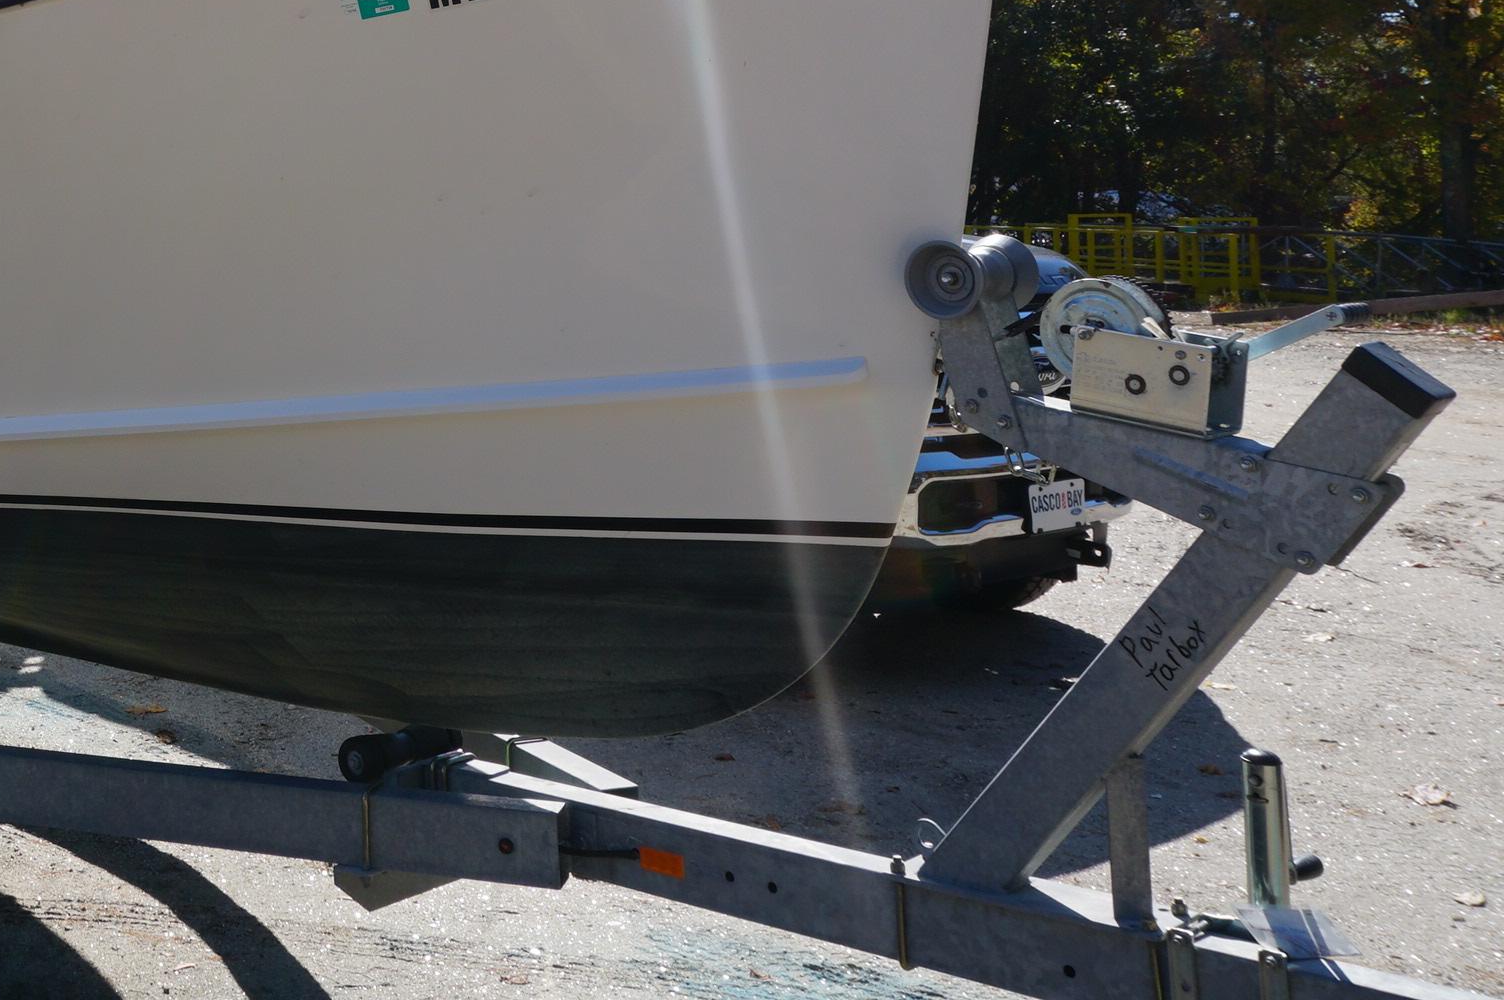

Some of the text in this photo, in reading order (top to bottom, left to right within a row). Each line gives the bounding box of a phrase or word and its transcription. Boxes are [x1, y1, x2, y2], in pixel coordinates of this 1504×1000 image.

[1031, 492, 1061, 514] CASCO
[1067, 489, 1083, 508] BAY
[1118, 605, 1167, 669] Paul
